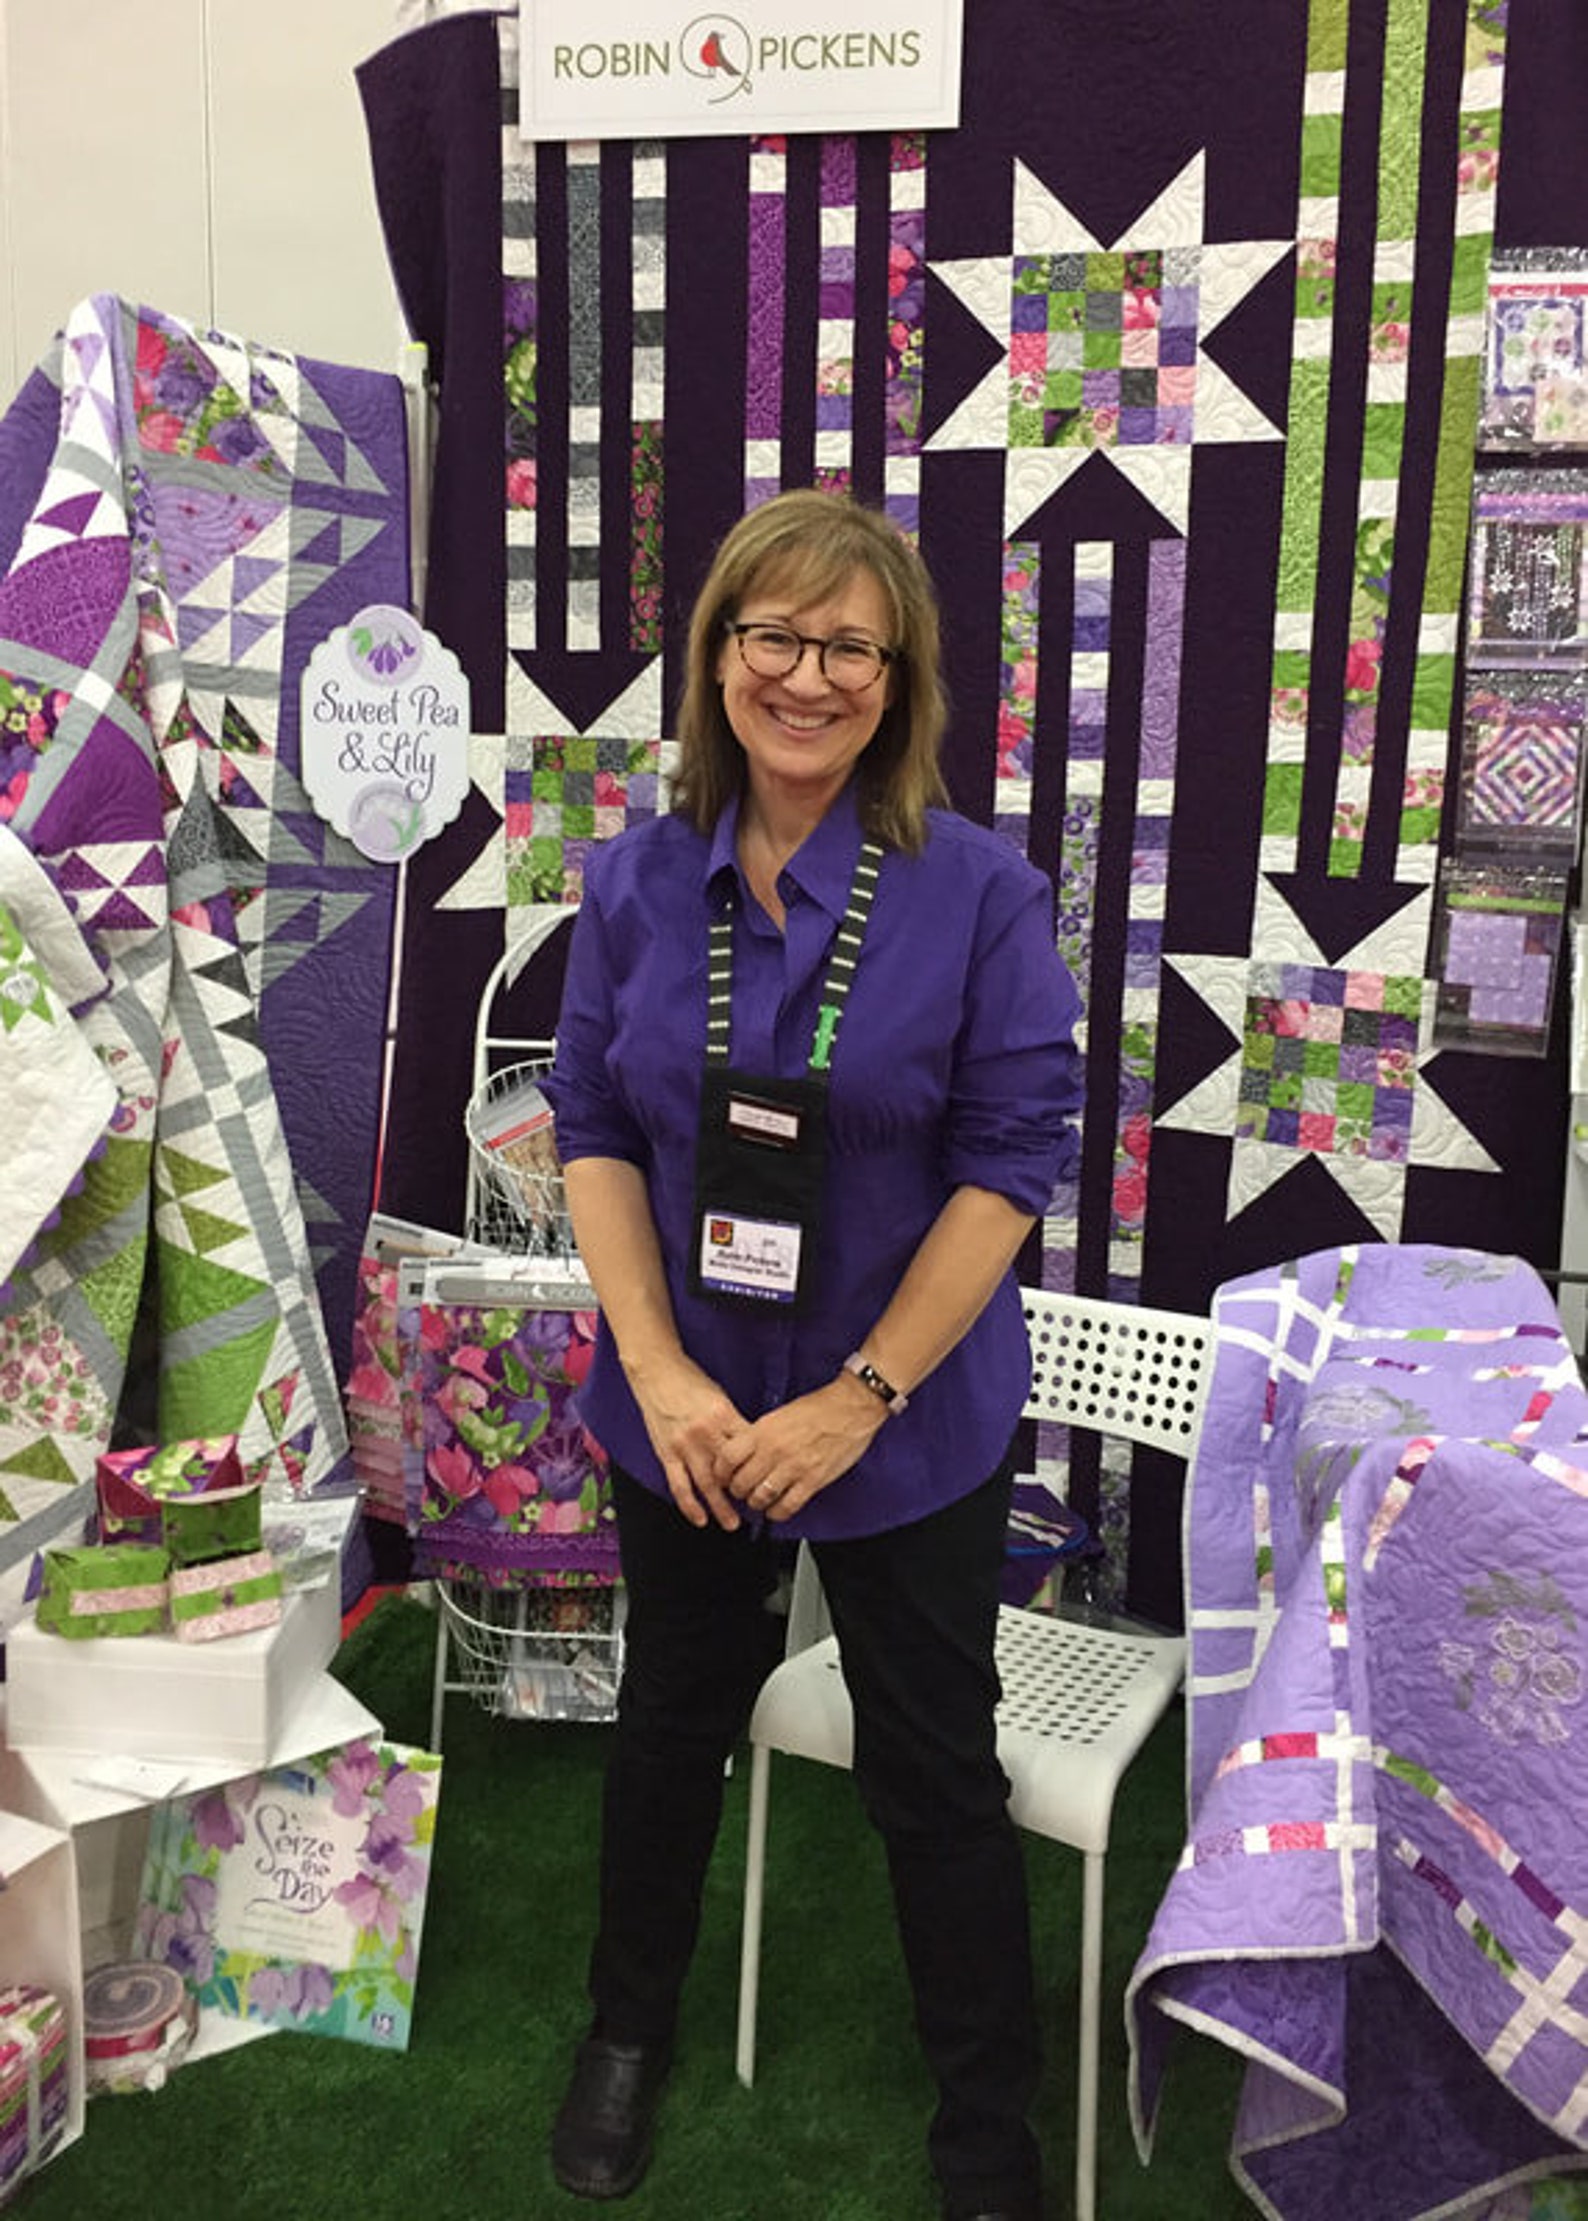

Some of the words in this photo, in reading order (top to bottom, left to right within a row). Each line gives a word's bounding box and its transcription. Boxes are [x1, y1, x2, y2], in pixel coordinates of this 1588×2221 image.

[553, 41, 671, 79] ROBIN
[758, 30, 922, 72] PICKENS
[313, 680, 400, 725] Sweet
[409, 685, 460, 728] Pea
[338, 731, 371, 773] &
[371, 732, 437, 803] Lily
[254, 1804, 334, 1876] Seize
[244, 1867, 335, 1914] Day
